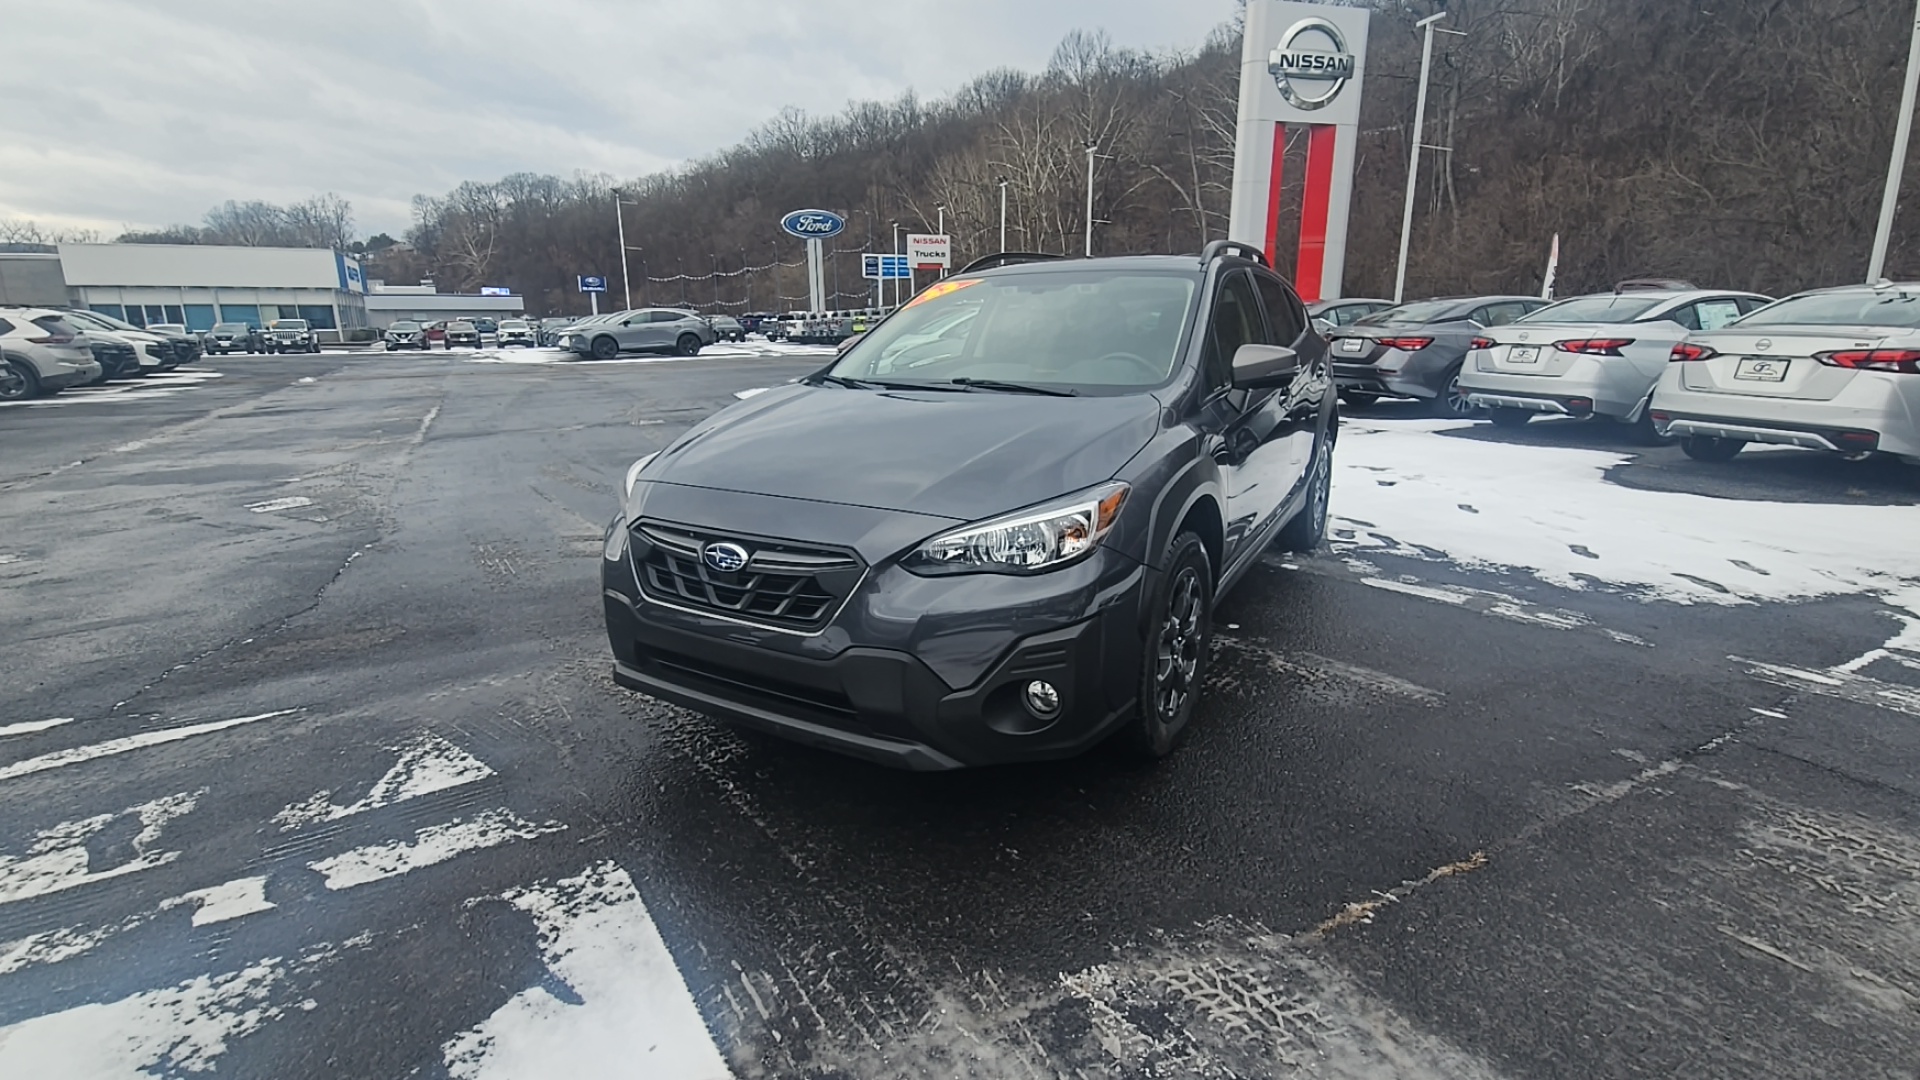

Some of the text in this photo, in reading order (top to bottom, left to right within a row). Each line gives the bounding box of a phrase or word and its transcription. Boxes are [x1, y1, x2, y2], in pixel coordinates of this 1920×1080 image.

[1279, 53, 1349, 72] NISSAN
[796, 215, 833, 232] Ford
[914, 250, 946, 258] Trucks
